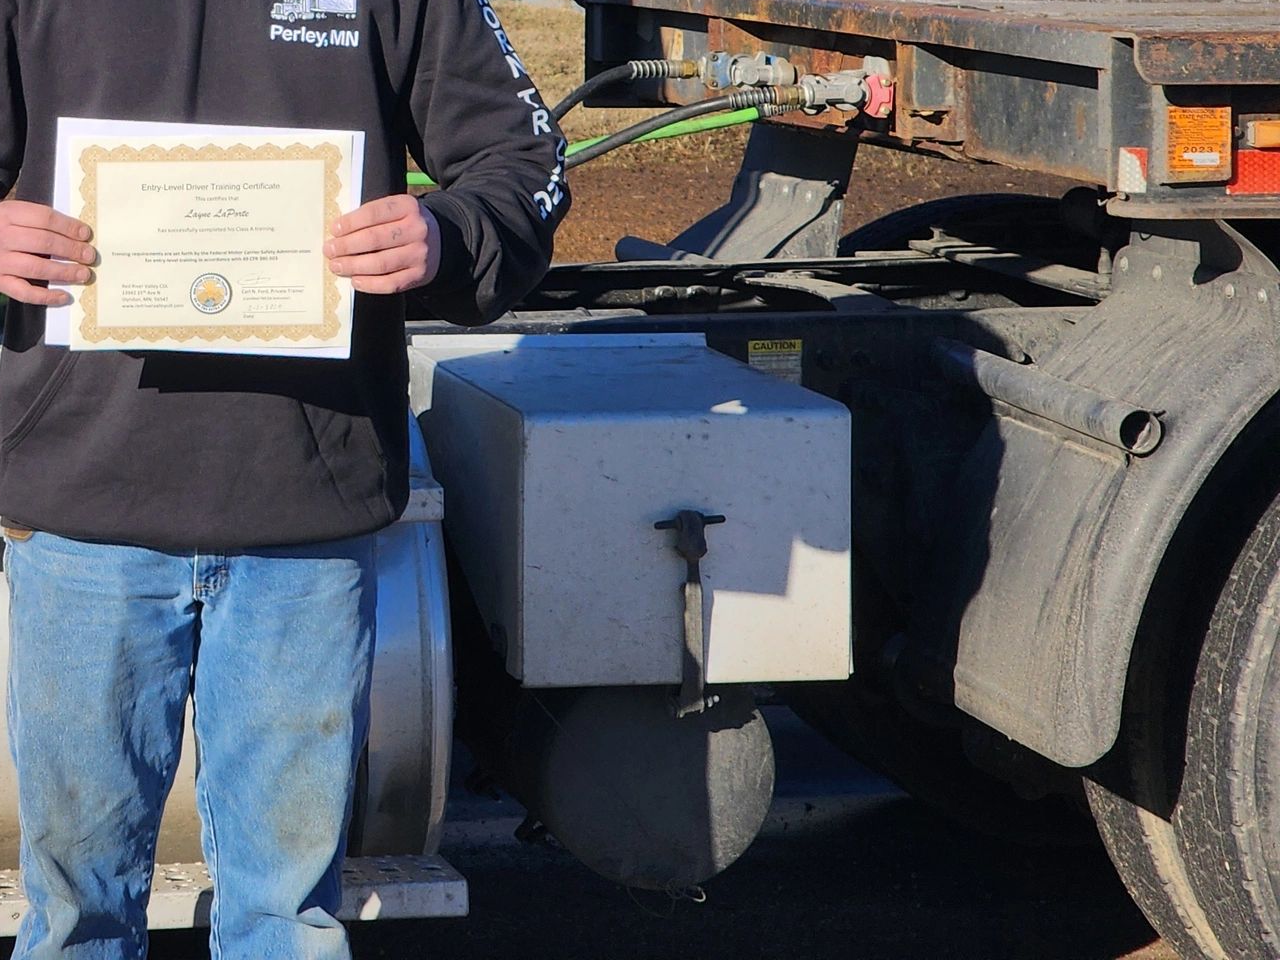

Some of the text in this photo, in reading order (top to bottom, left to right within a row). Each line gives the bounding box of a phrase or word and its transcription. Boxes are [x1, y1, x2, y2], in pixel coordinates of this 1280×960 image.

[141, 181, 280, 192] Entry-Level Driver Training Certificate
[753, 342, 796, 351] CAUTION
